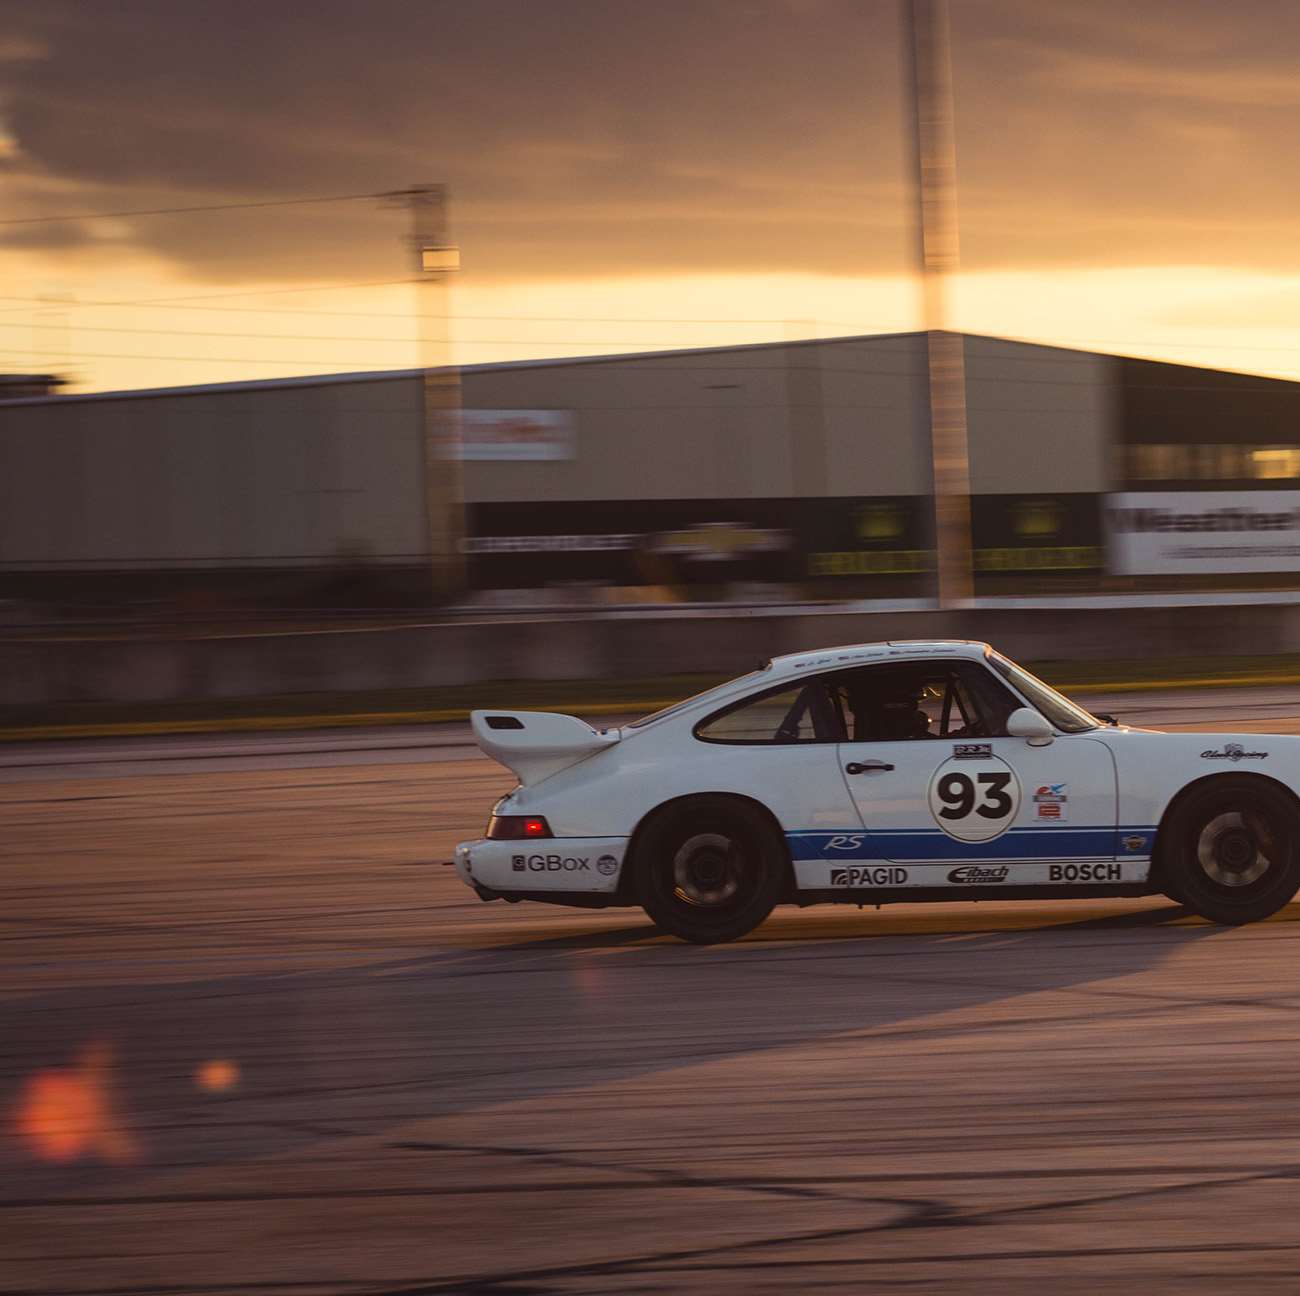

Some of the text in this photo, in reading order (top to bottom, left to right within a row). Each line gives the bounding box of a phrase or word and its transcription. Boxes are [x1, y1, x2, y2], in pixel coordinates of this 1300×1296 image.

[937, 772, 1013, 820] 93
[823, 835, 865, 850] RS
[527, 854, 592, 872] GBox
[848, 868, 908, 885] PAGID
[947, 866, 1009, 883] Eibach
[1048, 863, 1123, 881] BOSCH
